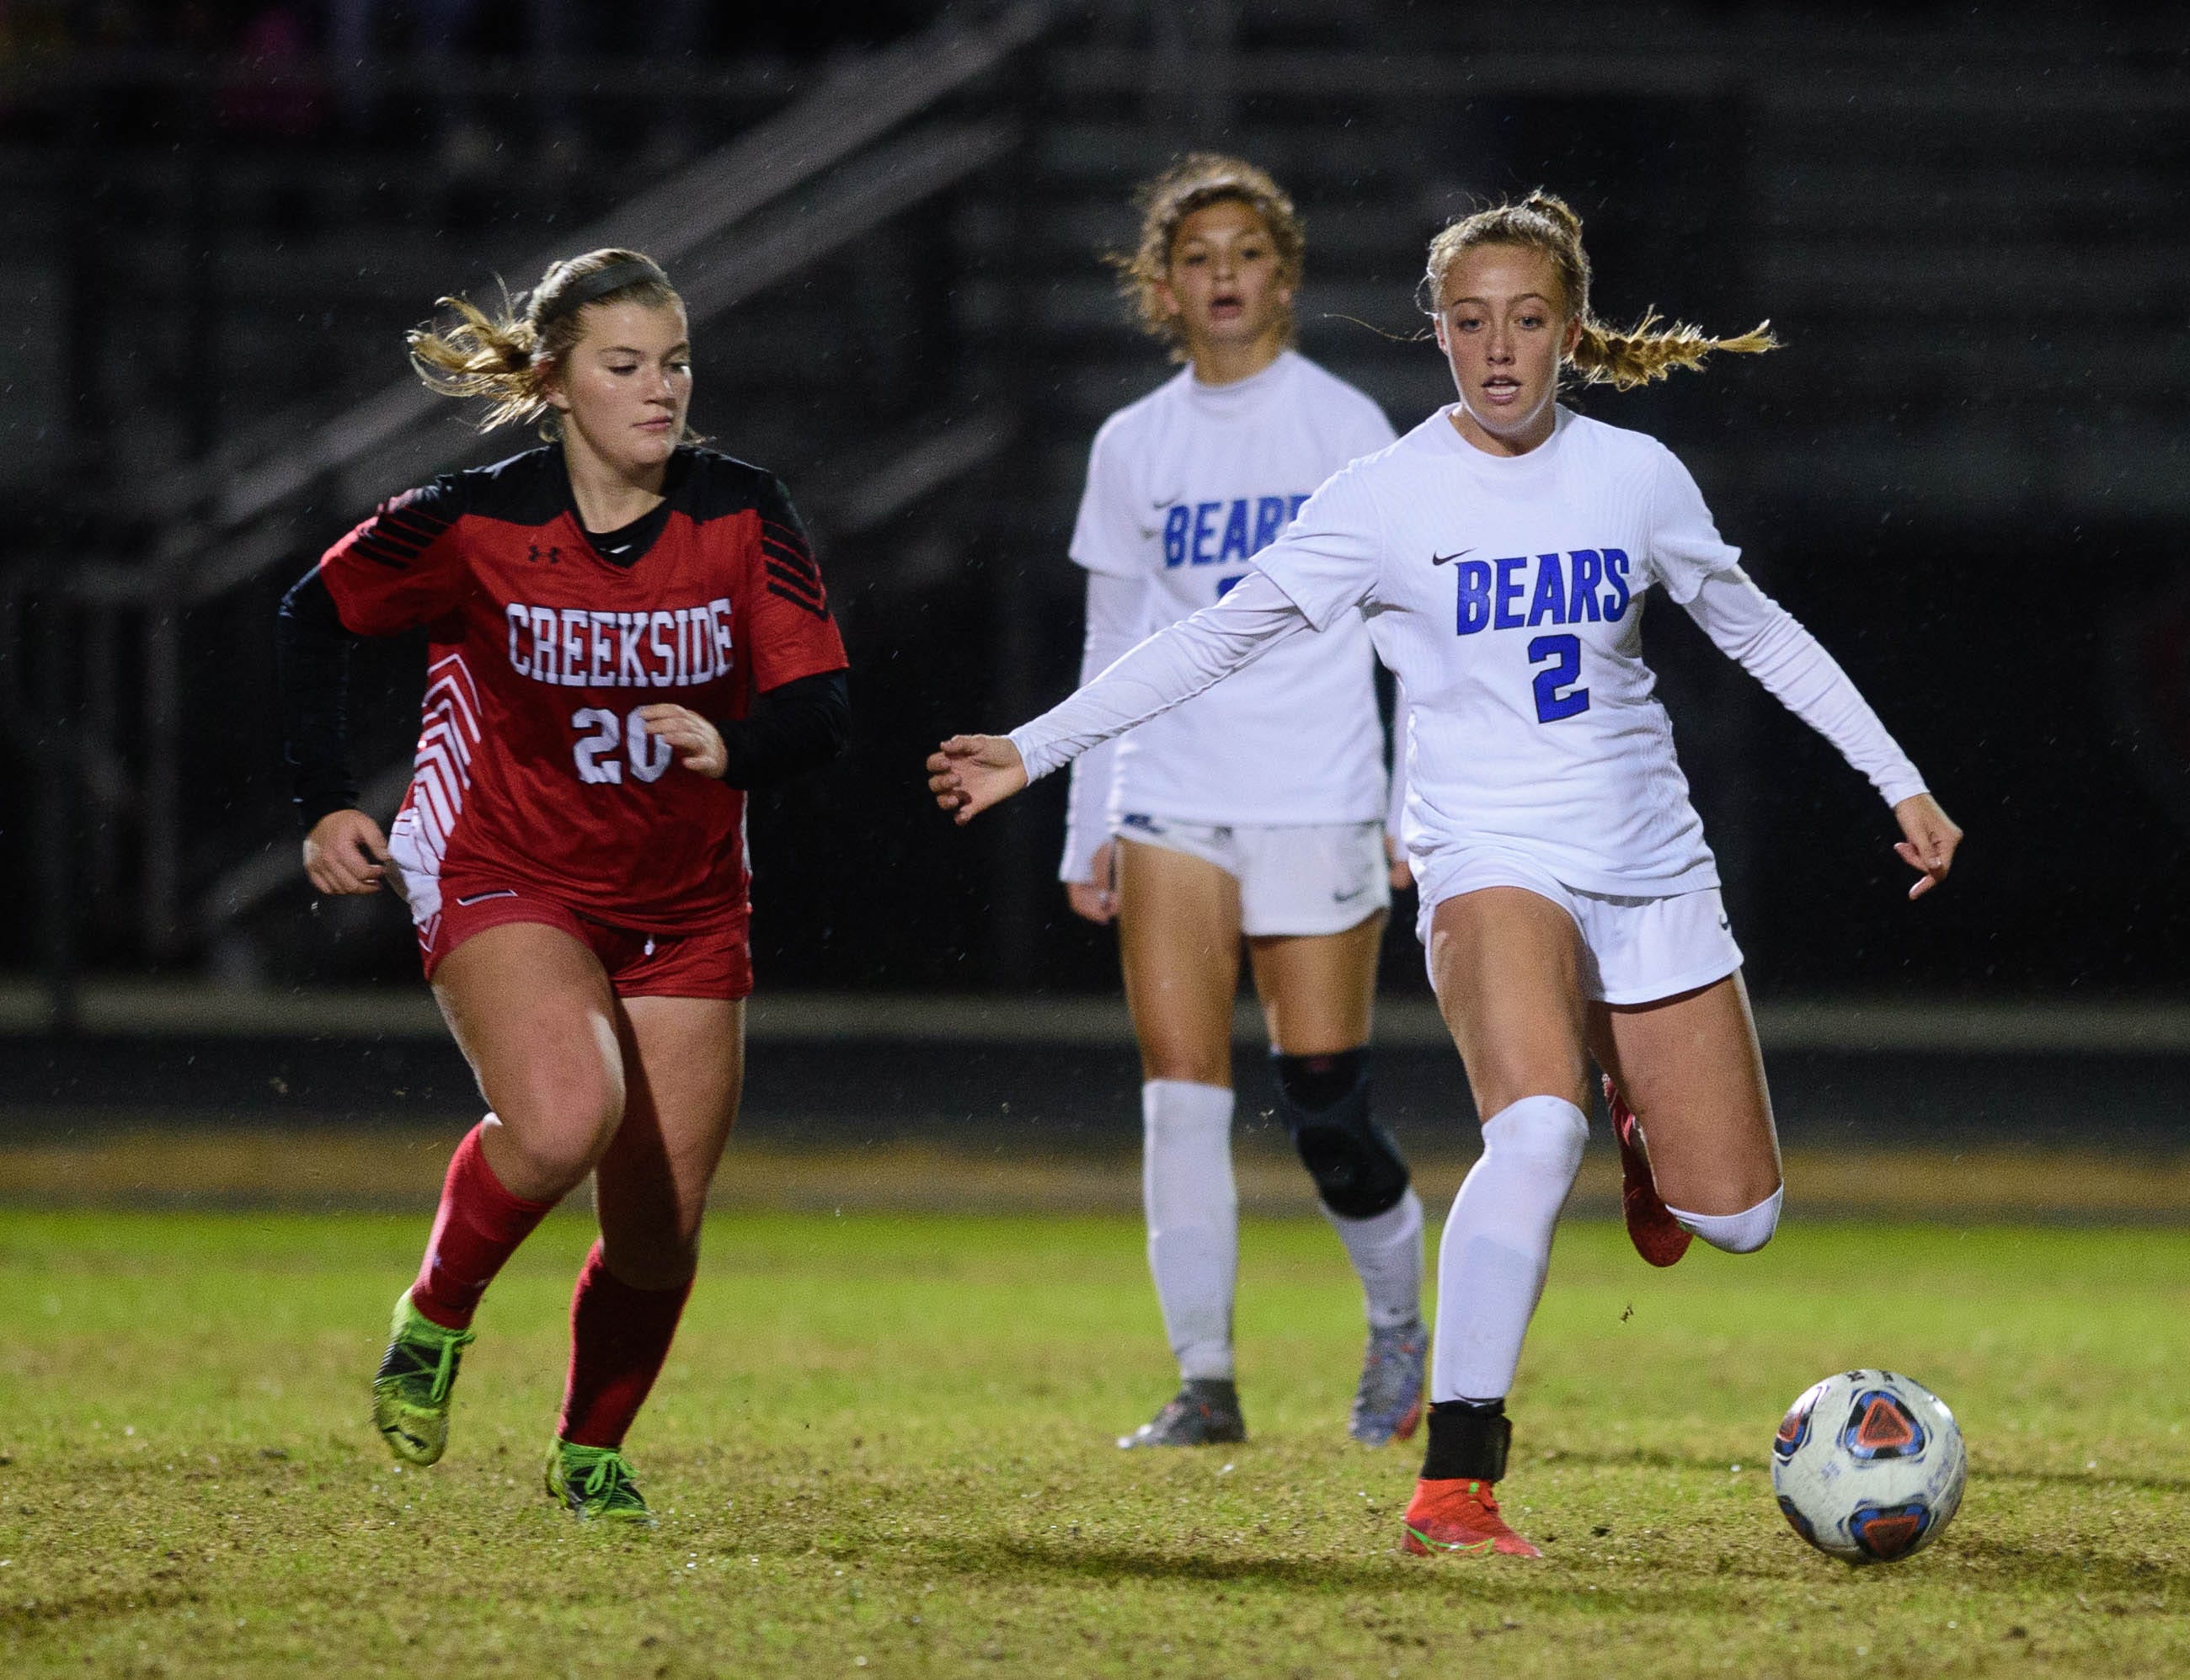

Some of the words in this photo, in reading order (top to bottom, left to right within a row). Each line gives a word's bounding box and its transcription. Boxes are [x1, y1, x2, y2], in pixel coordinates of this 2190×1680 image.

[1455, 548, 1630, 636] BEARS
[506, 598, 733, 687] CREEKSIDE
[1528, 634, 1590, 723] 2
[572, 707, 671, 784] 20
